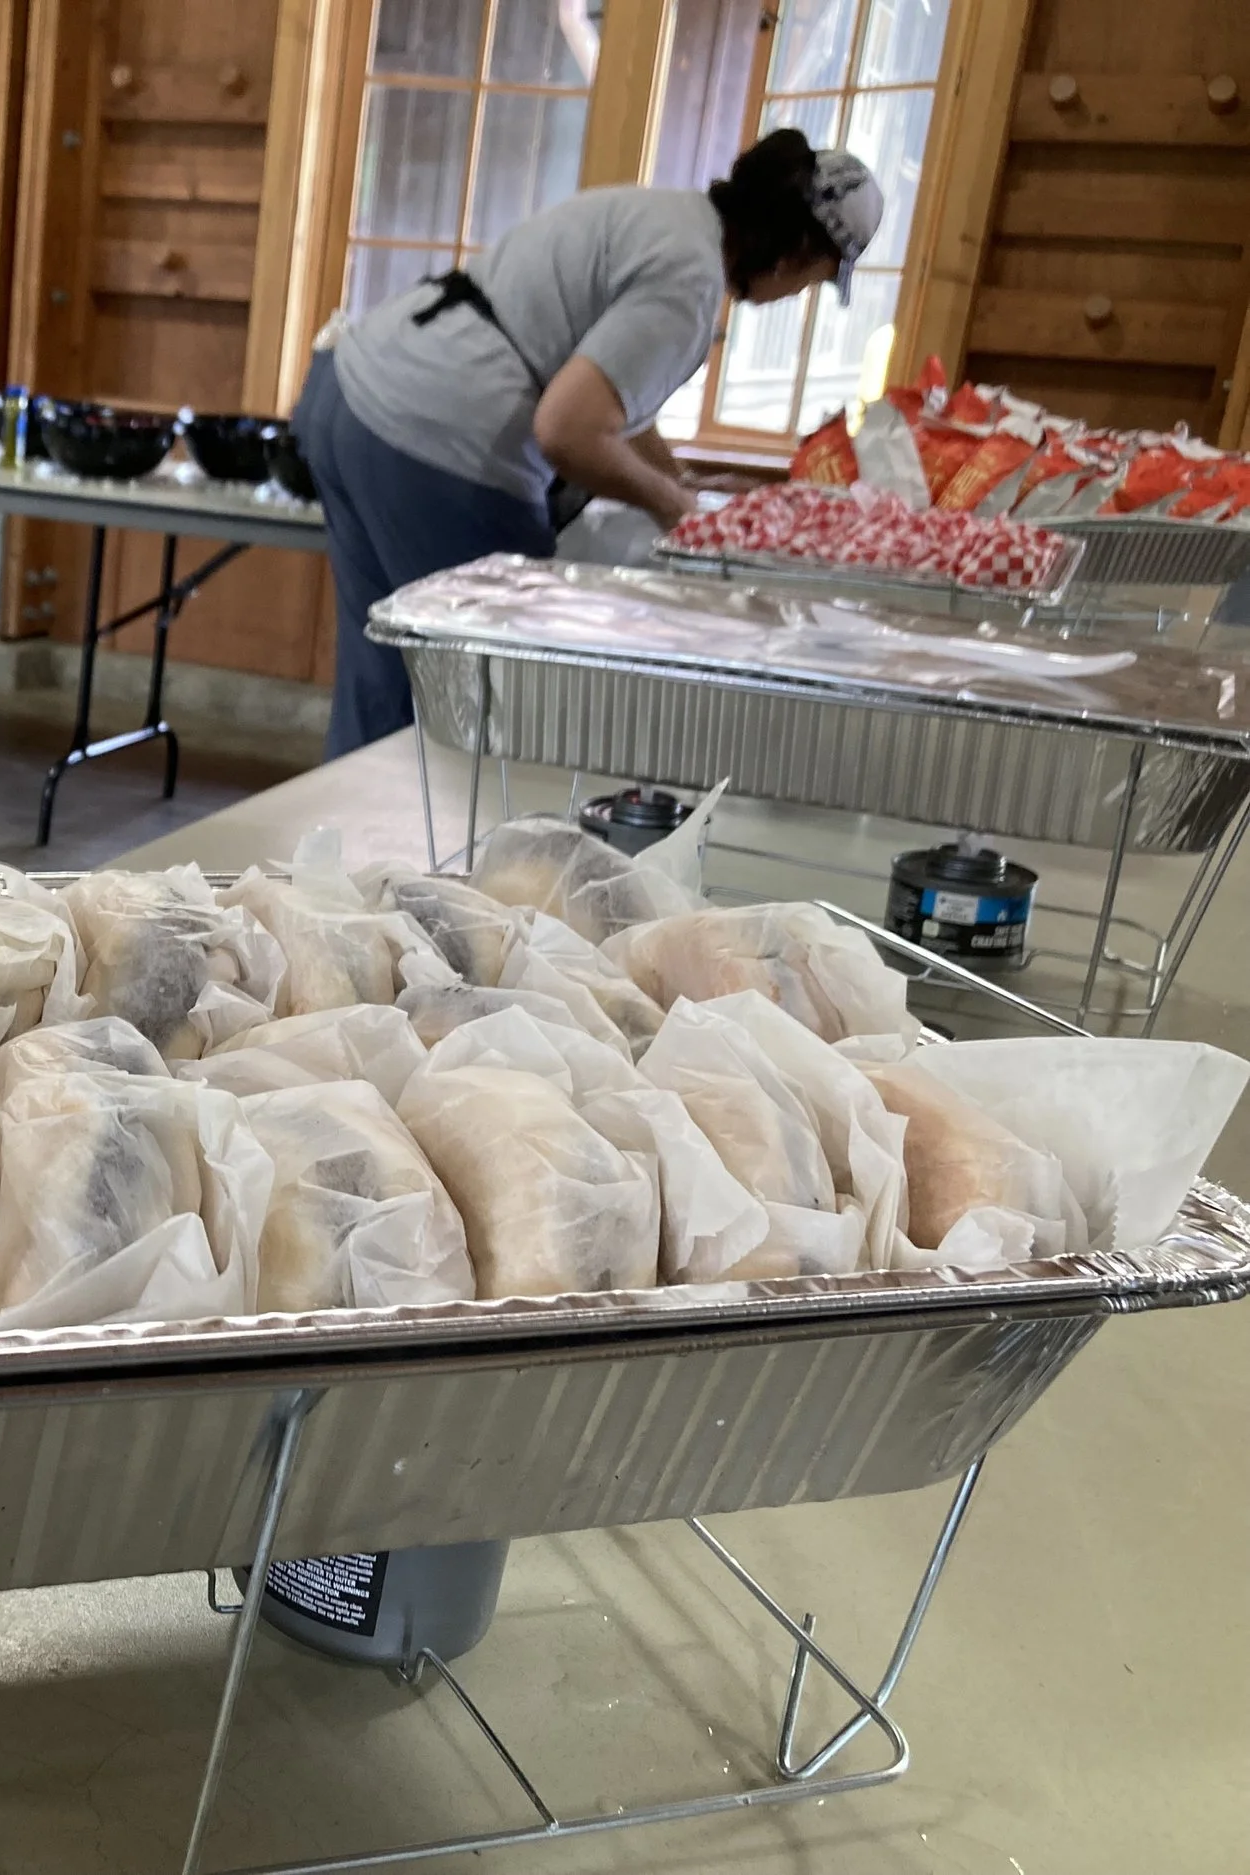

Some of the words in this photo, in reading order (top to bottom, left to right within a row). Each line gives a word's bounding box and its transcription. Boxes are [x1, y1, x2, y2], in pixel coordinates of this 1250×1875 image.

[287, 1568, 297, 1578] AID
[297, 1573, 340, 1598] INFORMATION.
[296, 1566, 331, 1587] ADDITIONAL
[333, 1582, 369, 1598] WARNINGS
[307, 1563, 324, 1576] REFER
[326, 1571, 333, 1580] TO
[335, 1575, 355, 1587] OUTER
